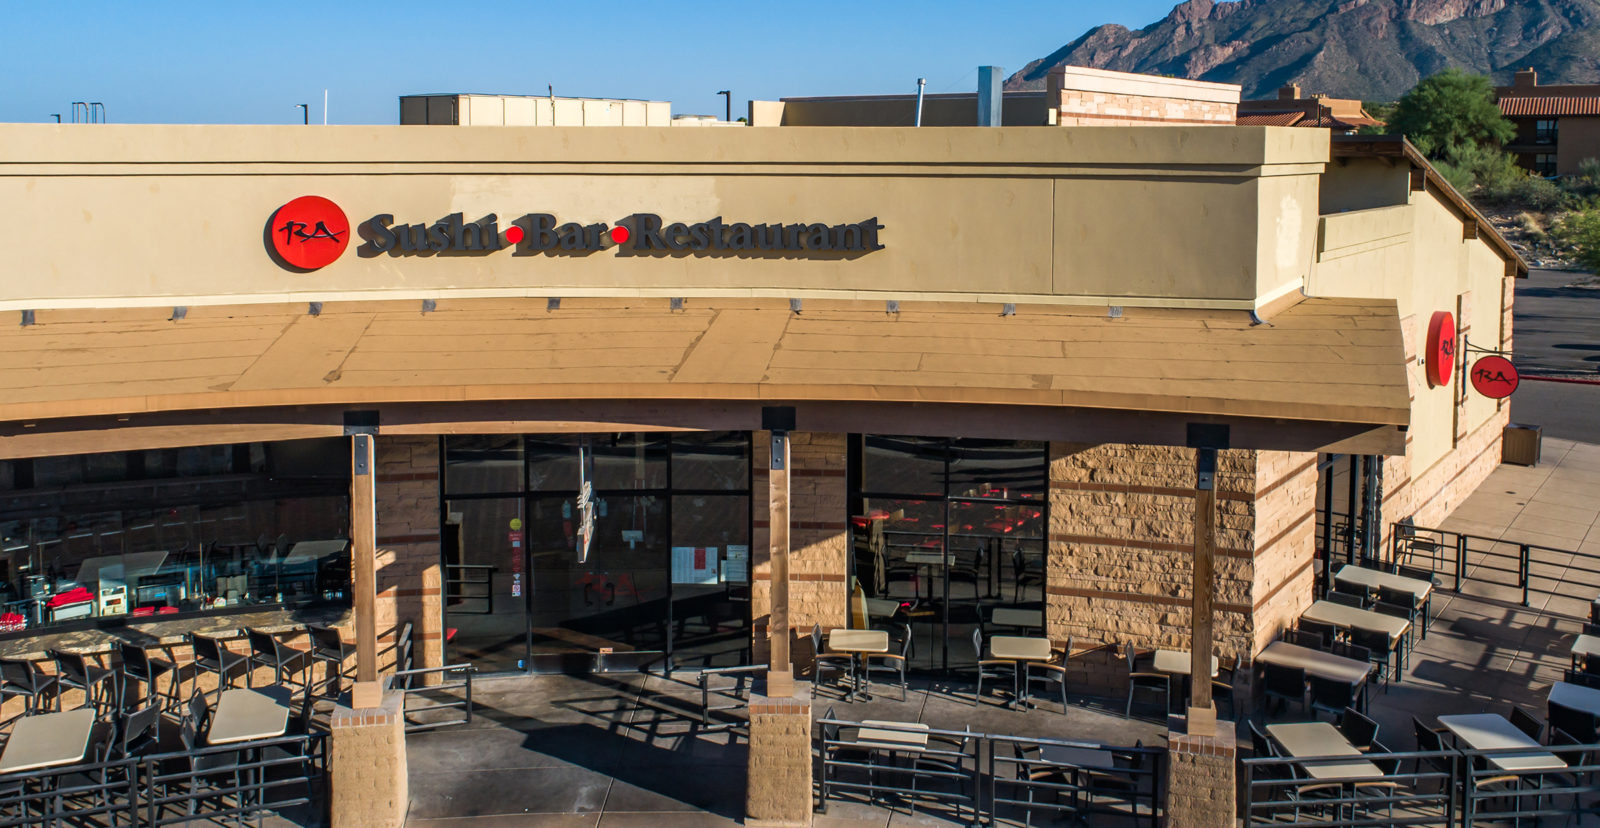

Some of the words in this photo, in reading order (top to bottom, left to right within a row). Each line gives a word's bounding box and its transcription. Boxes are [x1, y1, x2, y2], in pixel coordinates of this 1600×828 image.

[278, 219, 346, 246] RA
[360, 212, 499, 254] Sushi
[518, 213, 609, 254] Bar
[623, 213, 885, 255] Restaurant
[1474, 368, 1516, 386] RA
